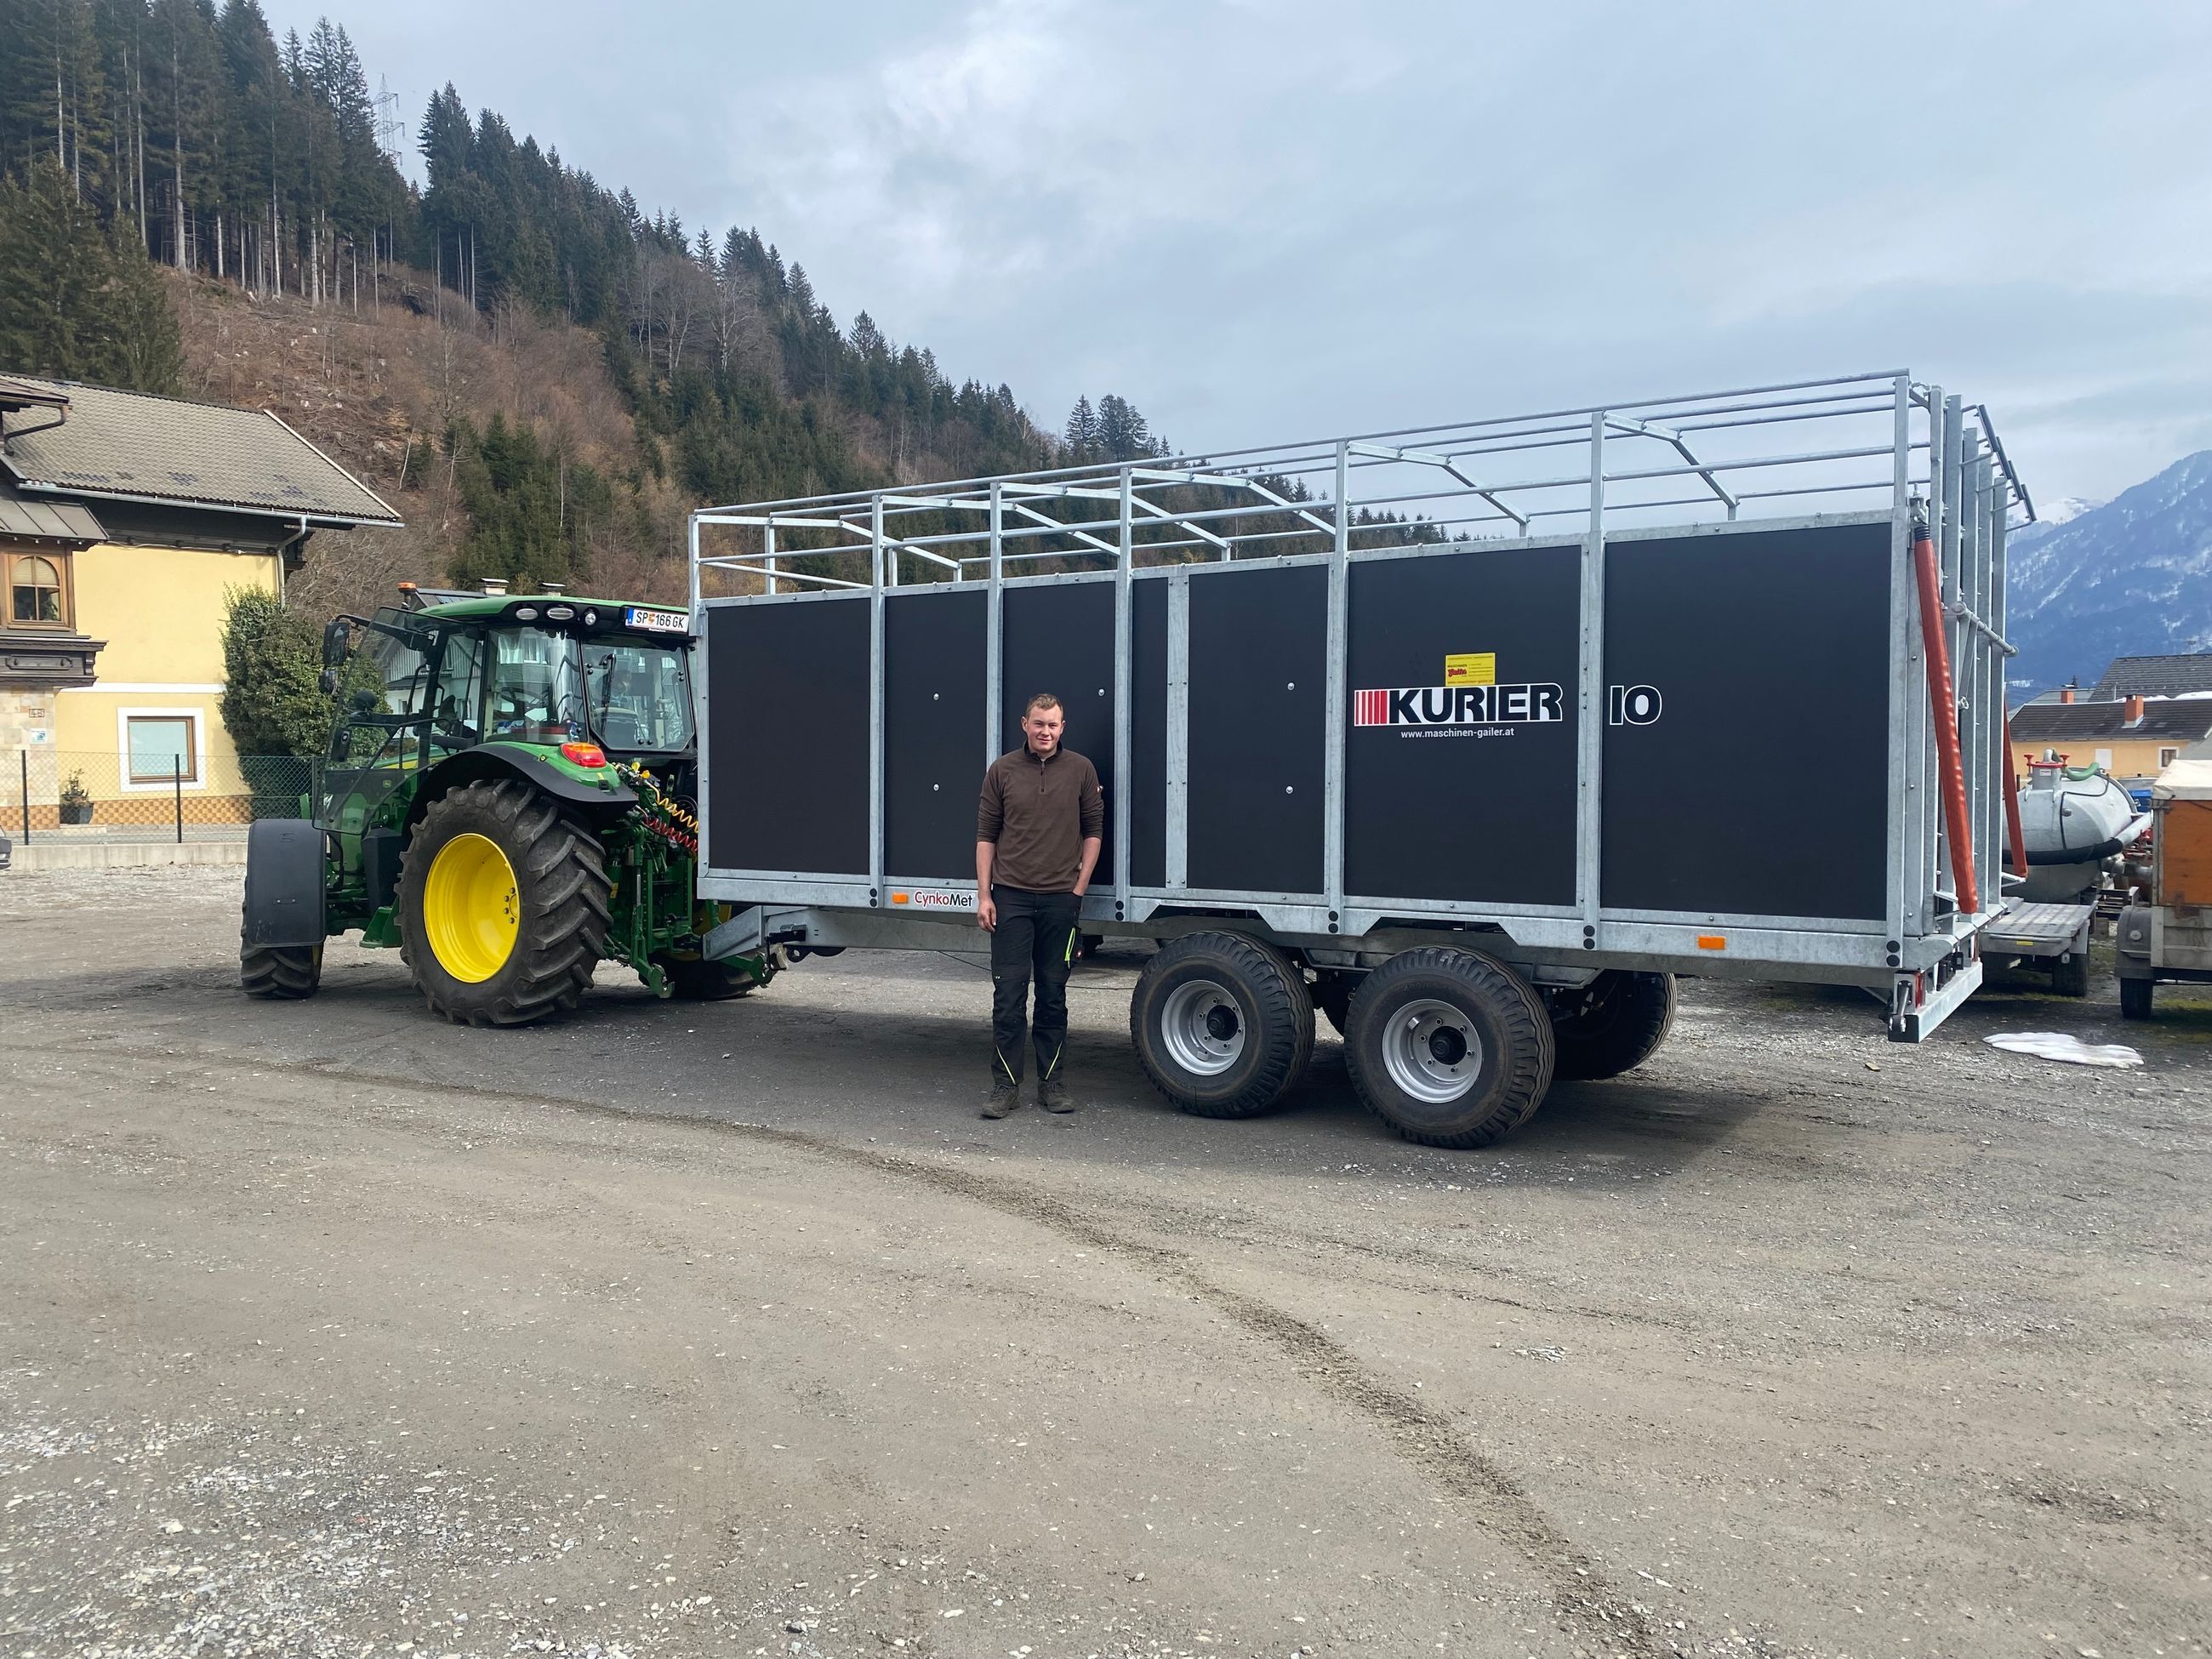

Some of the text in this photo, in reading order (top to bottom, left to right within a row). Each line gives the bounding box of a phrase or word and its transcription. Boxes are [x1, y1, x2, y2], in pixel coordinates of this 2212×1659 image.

[636, 612, 685, 629] SP 166 GK
[1387, 682, 1564, 725] KURIER
[1400, 727, 1514, 738] www.maschinen-gailer.at
[914, 891, 973, 908] CynkoMet
